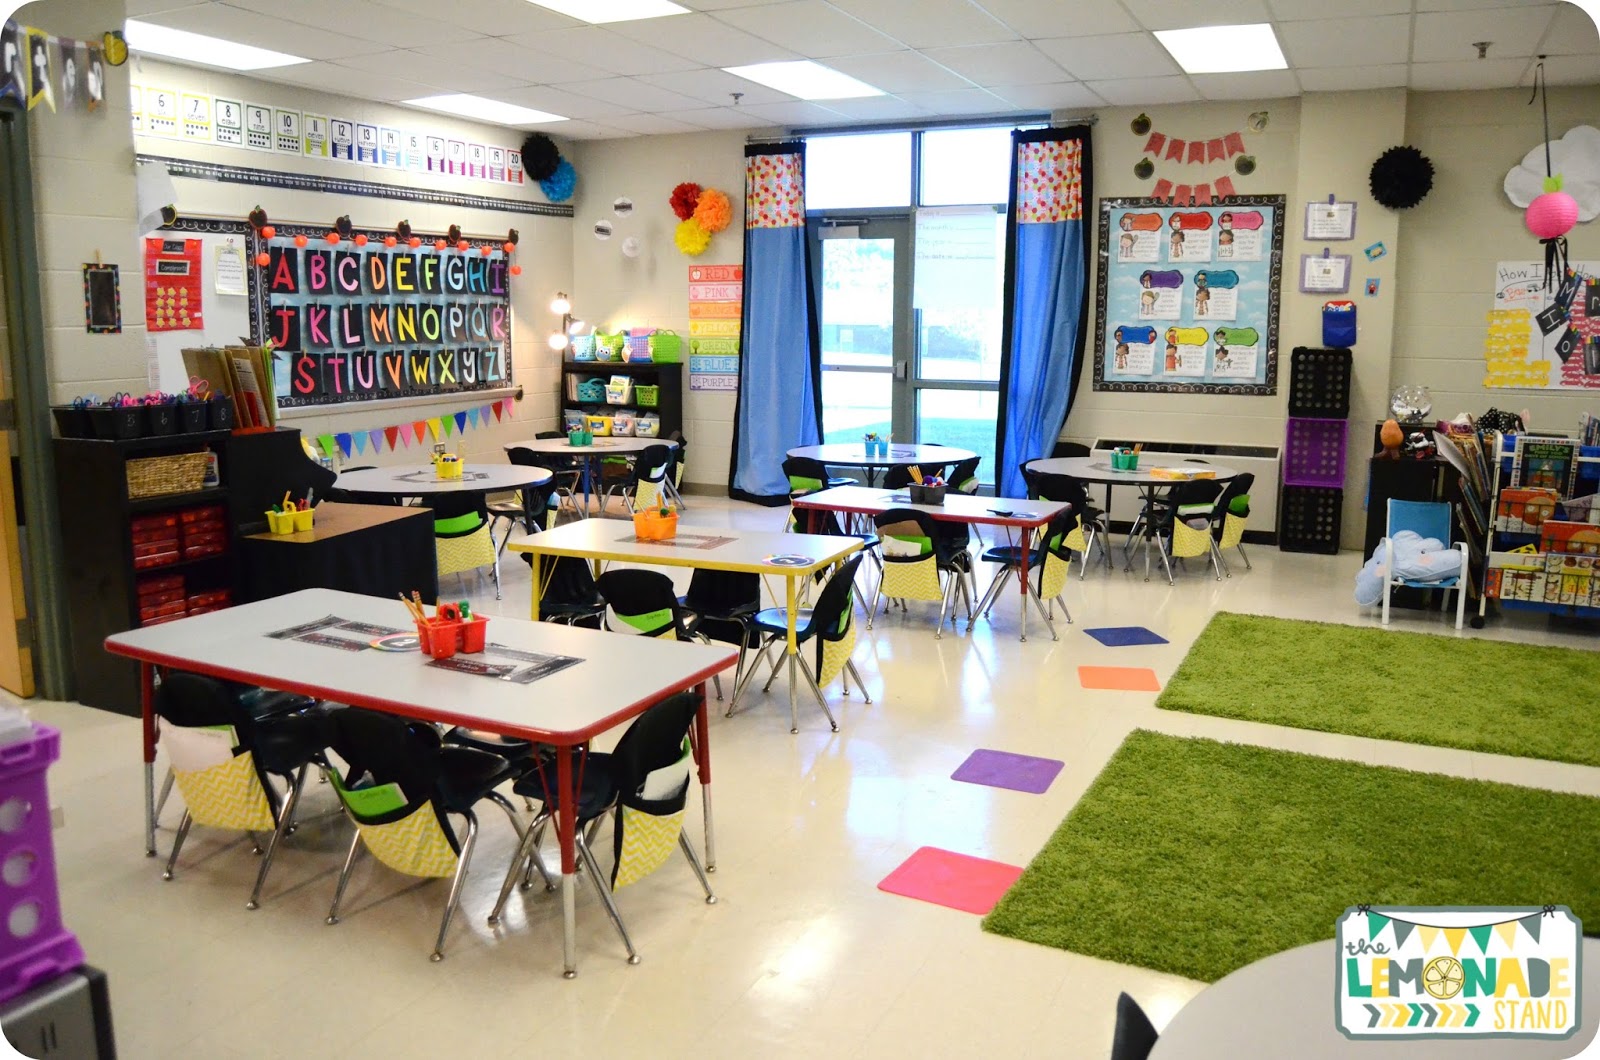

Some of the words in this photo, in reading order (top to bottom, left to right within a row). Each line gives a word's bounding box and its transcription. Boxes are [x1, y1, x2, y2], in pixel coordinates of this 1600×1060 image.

[158, 94, 165, 107] 6
[194, 100, 199, 112] 7
[225, 105, 232, 118] 8
[255, 110, 262, 124] 9
[283, 114, 292, 128] 10
[312, 120, 318, 132] 11
[338, 124, 346, 136] 12
[363, 128, 370, 140] 13
[387, 132, 394, 144] 14
[410, 136, 417, 148] 15
[432, 141, 438, 151] 16
[454, 144, 460, 154] 17
[511, 154, 519, 164] 20
[272, 255, 296, 290] A
[310, 254, 326, 290] B
[338, 256, 358, 291] C
[371, 256, 386, 290] D
[396, 258, 414, 290] E
[424, 258, 438, 290] F
[448, 258, 462, 290] G
[469, 262, 486, 292] H
[492, 264, 504, 294] I
[706, 268, 730, 279] RED
[1499, 268, 1528, 282] How
[1530, 264, 1544, 278] I
[704, 287, 728, 298] PINK
[1560, 282, 1575, 306] M
[272, 310, 296, 348] J
[310, 306, 330, 344] K
[344, 308, 360, 344] L
[370, 308, 392, 344] M
[398, 306, 418, 342] N
[422, 308, 440, 340] O
[450, 307, 463, 338] P
[472, 307, 486, 338] Q
[492, 308, 506, 338] R
[700, 324, 737, 334] YELLOW
[702, 342, 732, 350] GREEN
[704, 359, 732, 370] BLUE
[294, 356, 316, 394] S
[328, 358, 344, 394] T
[356, 356, 374, 388] U
[385, 356, 402, 390] V
[412, 356, 430, 386] W
[438, 353, 456, 384] X
[486, 352, 500, 382] Z
[702, 378, 733, 387] PURPLE
[127, 413, 136, 426] 5
[161, 412, 168, 425] 6
[192, 410, 200, 422] 7
[220, 408, 226, 420] 8
